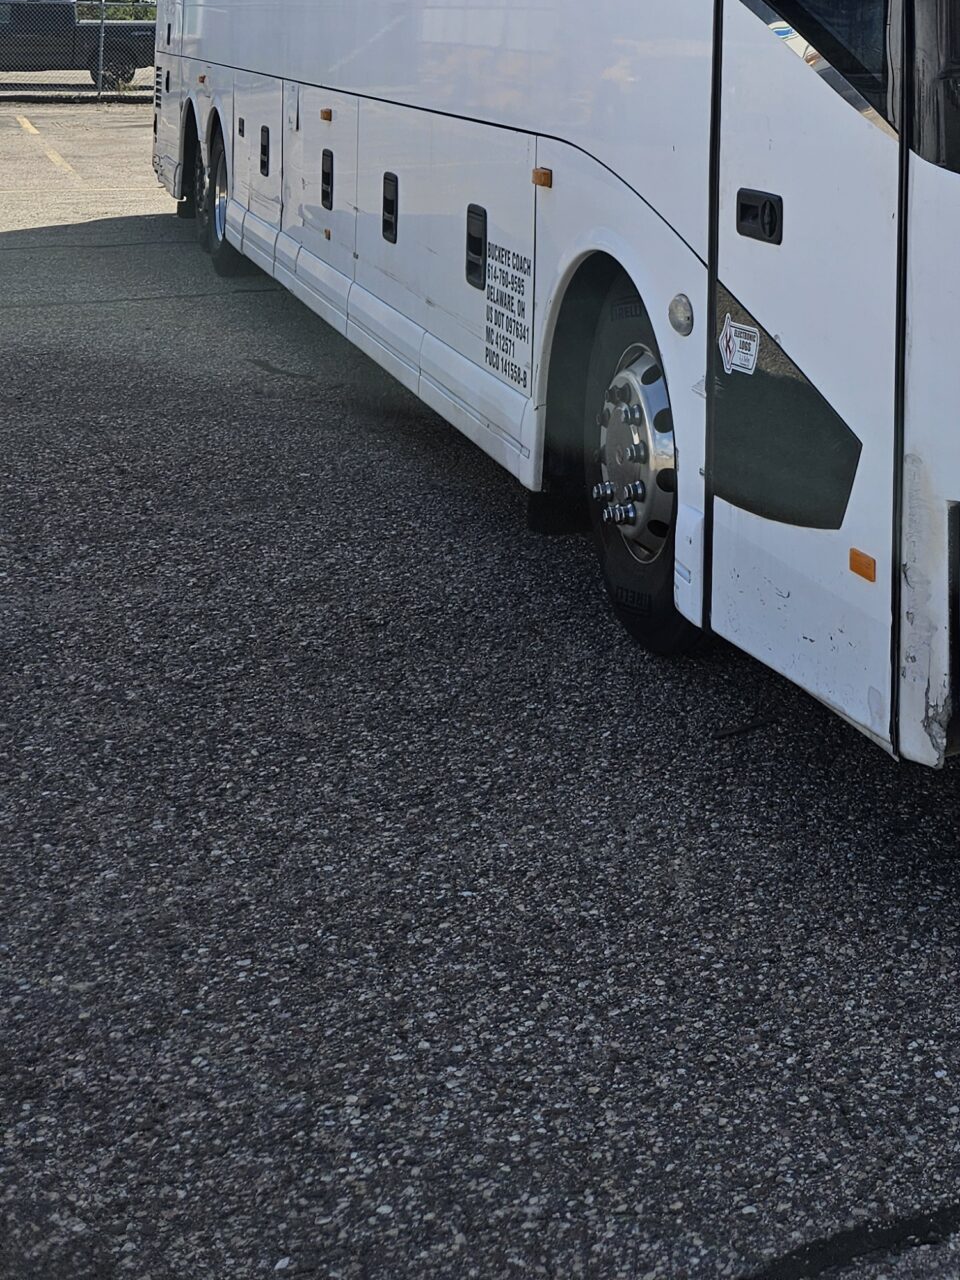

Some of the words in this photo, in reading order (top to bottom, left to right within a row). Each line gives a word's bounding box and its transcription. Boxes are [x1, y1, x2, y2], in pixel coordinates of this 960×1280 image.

[488, 241, 511, 268] BUCKEYE
[512, 251, 531, 277] COACH
[486, 284, 516, 317] DELAWARE,
[517, 299, 526, 319] OH
[486, 304, 493, 324] US
[494, 309, 505, 330] DOT
[485, 325, 495, 346] MC
[495, 331, 515, 358] 412571
[485, 346, 500, 371] PUCO
